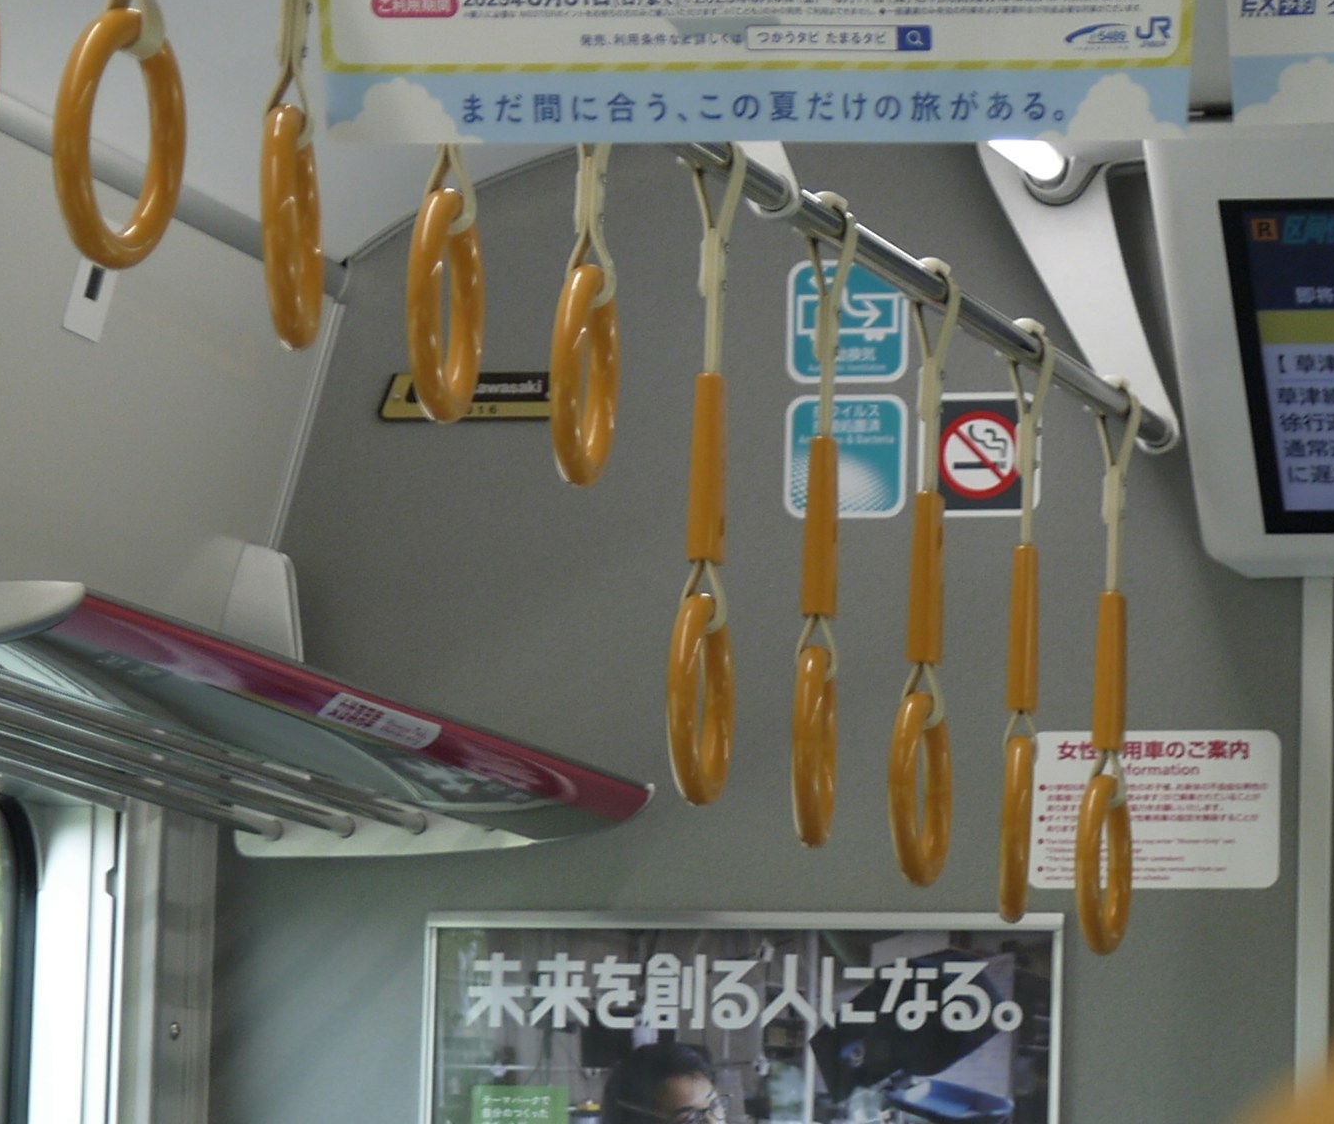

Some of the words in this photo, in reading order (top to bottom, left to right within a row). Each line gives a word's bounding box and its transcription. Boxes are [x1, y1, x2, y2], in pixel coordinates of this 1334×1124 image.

[757, 31, 820, 45] つかうタビ
[826, 31, 887, 45] たまるタビ
[1135, 16, 1172, 40] JR
[461, 84, 1068, 127] まだ間に合う、この夏だけの旅がある。
[474, 379, 543, 395] awasaki
[1057, 739, 1250, 761] 女性用車のご案内
[467, 952, 1024, 1033] 未来を創る人になる。
